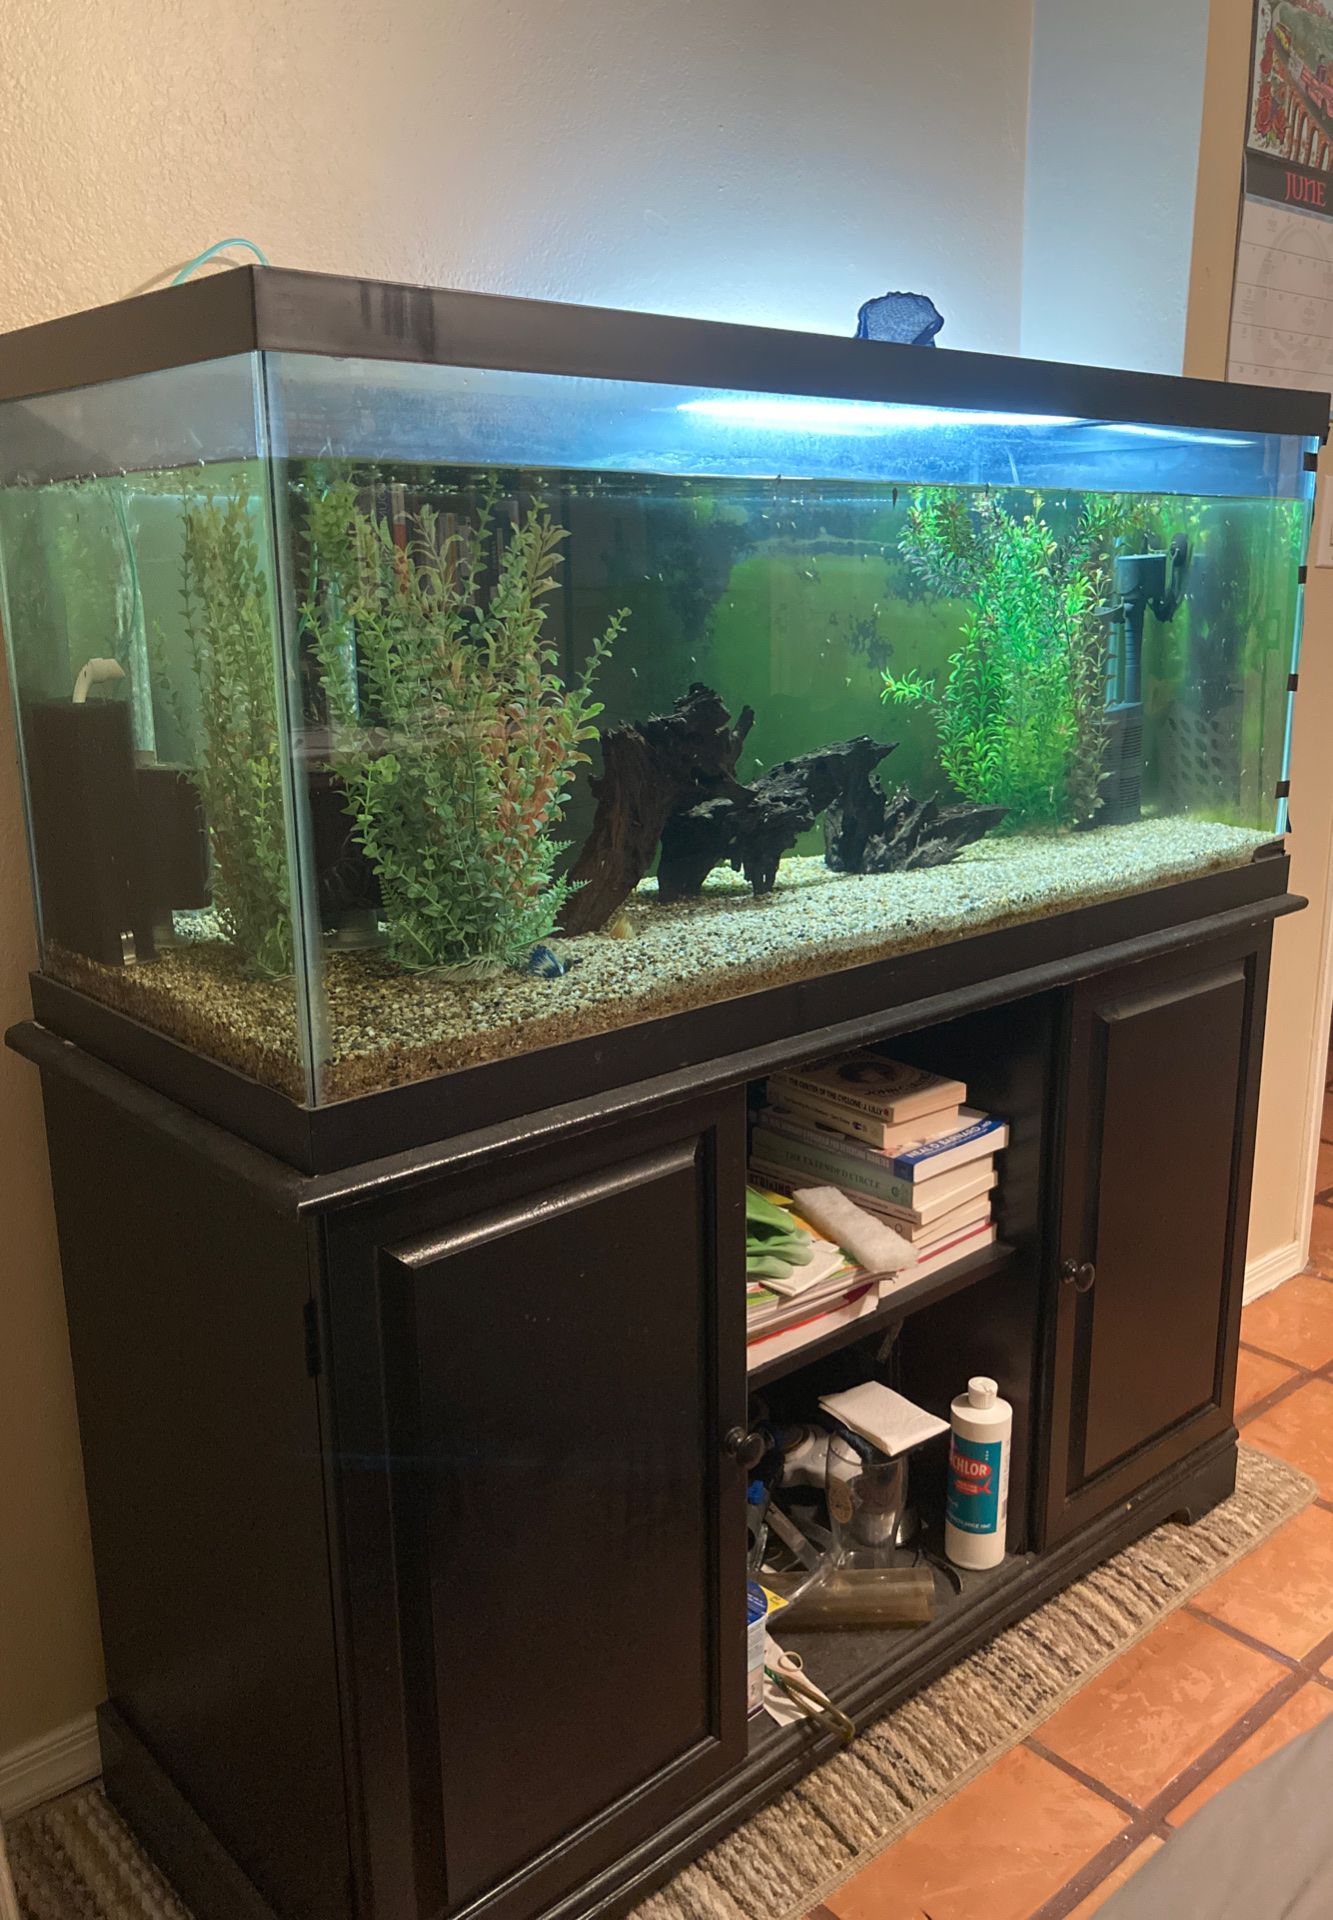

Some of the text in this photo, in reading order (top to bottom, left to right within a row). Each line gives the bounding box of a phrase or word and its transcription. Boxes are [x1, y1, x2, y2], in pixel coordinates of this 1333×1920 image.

[1284, 171, 1327, 208] JUNE
[837, 1093, 861, 1110] CYCLONE
[868, 1104, 883, 1116] LILLY
[785, 1151, 881, 1190] THE EXTENDED CIRCLE
